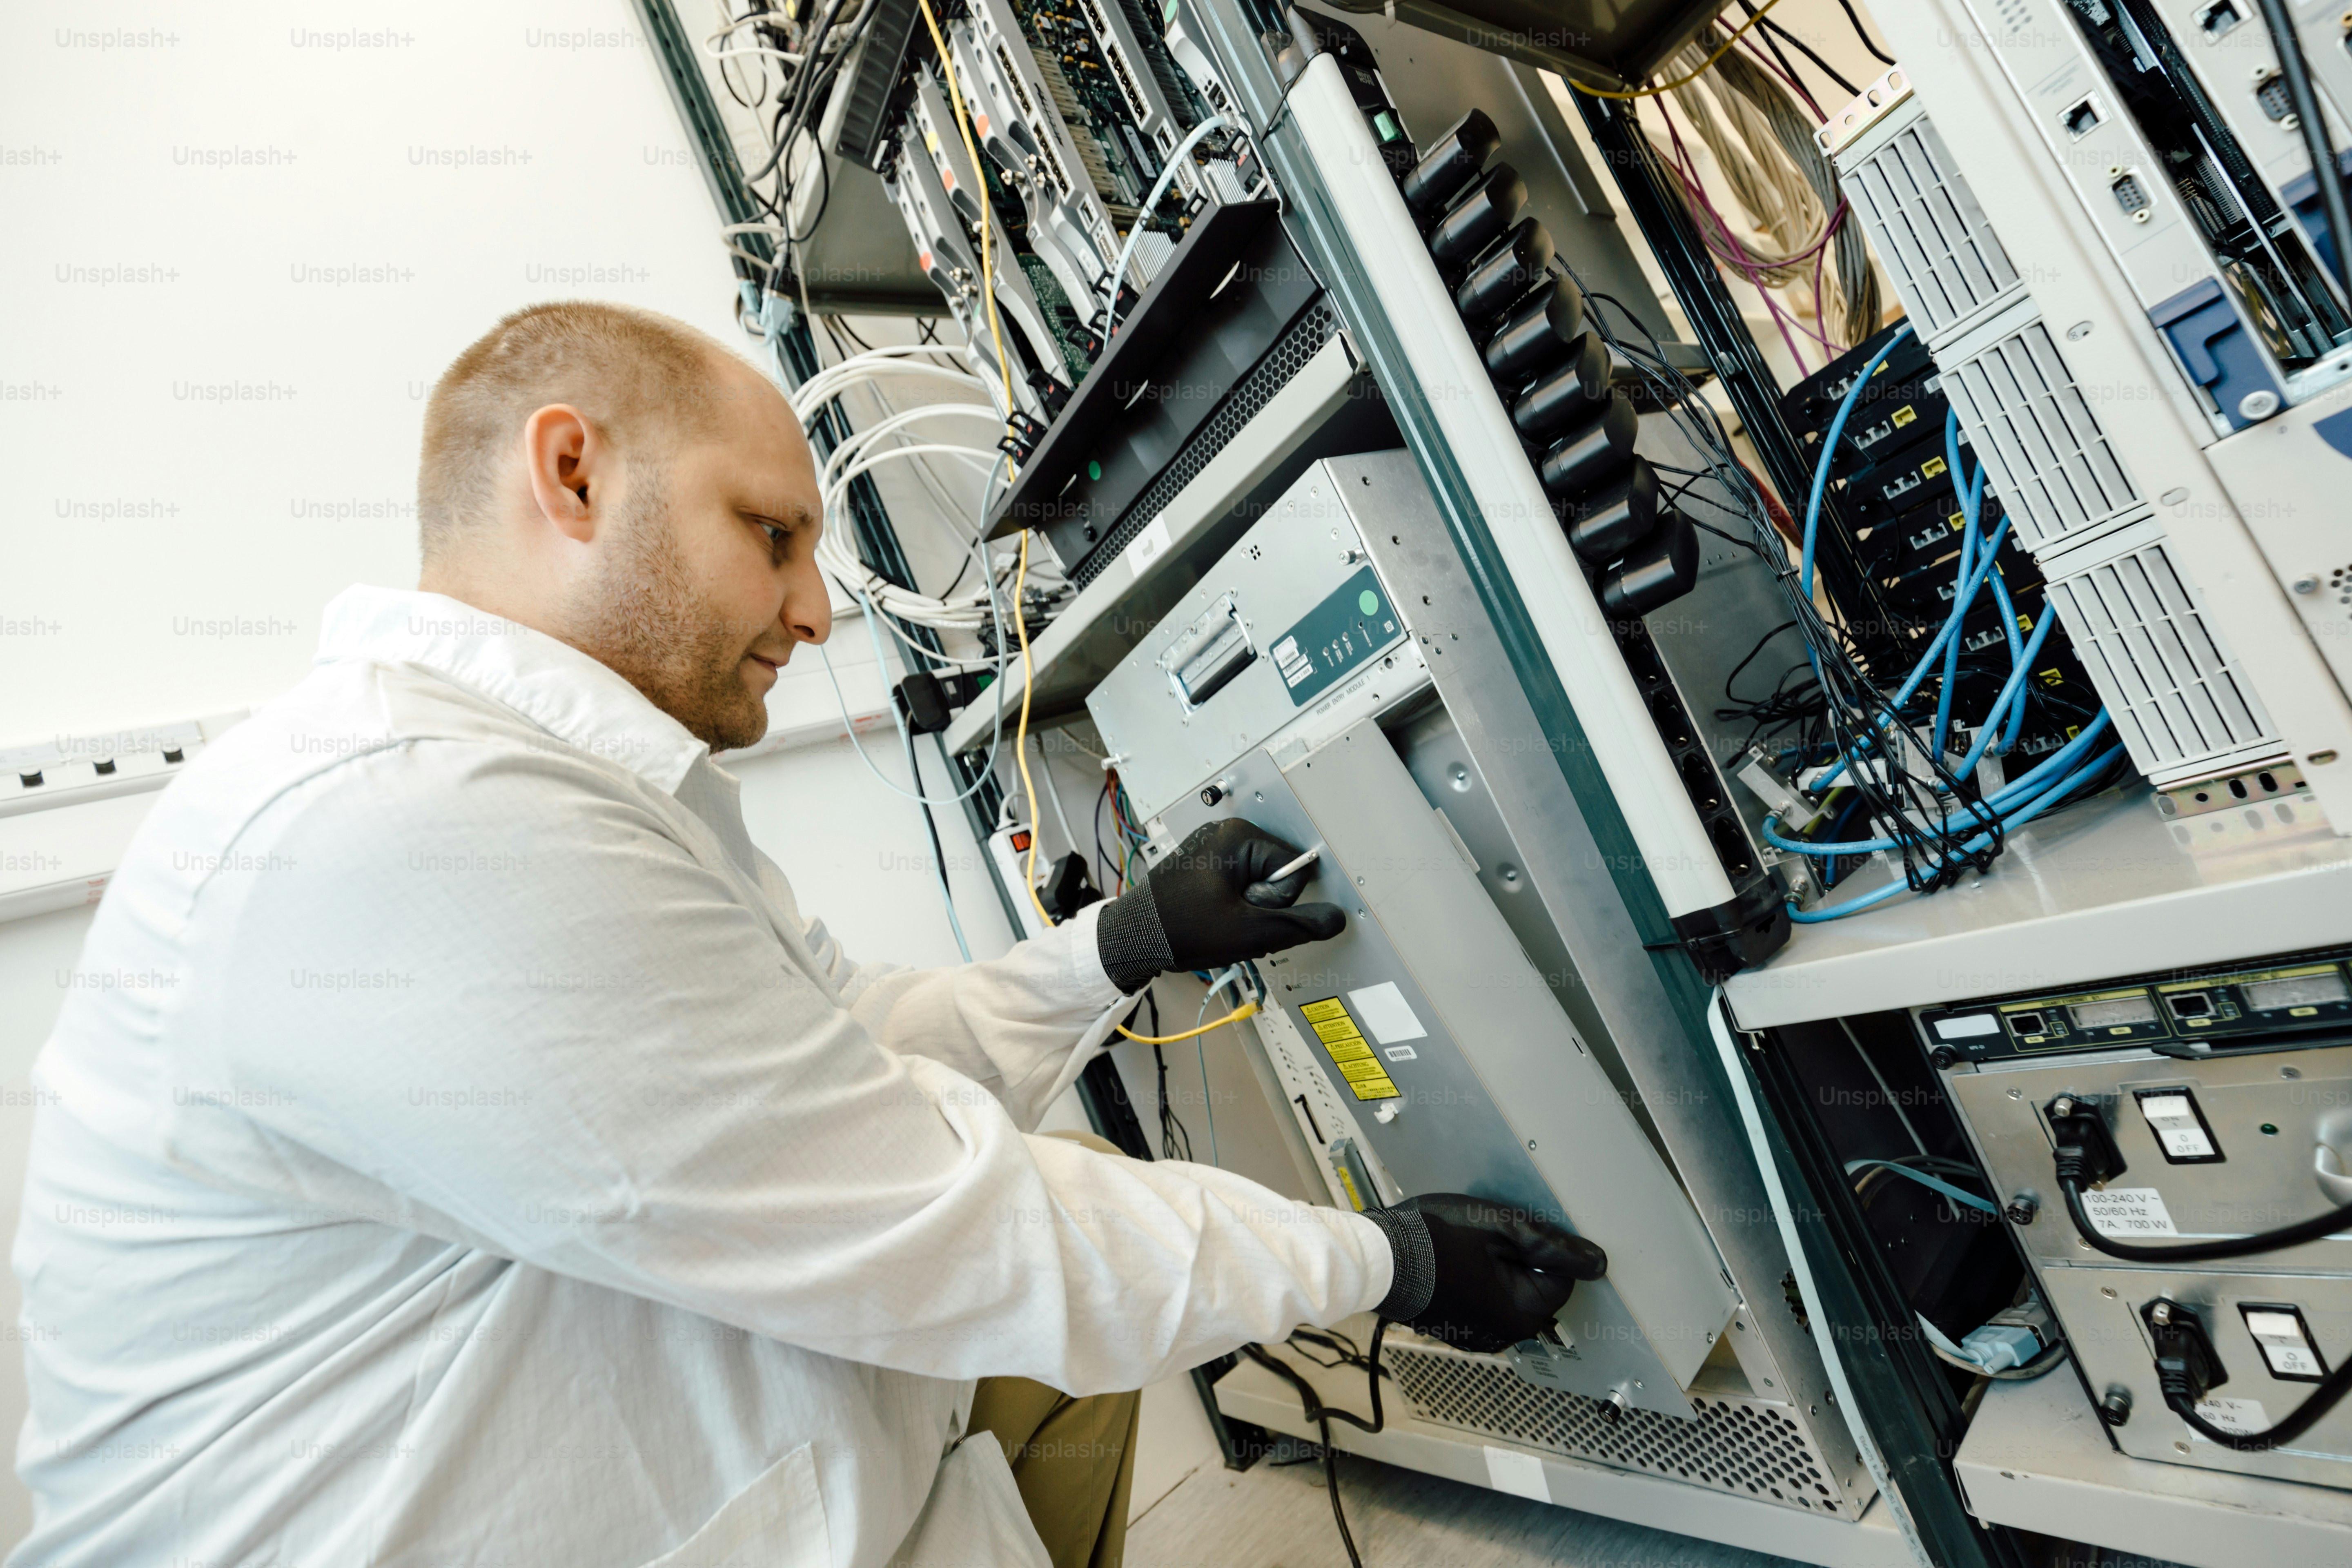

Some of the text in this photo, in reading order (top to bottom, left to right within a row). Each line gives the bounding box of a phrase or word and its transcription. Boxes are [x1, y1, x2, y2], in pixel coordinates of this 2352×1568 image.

[1316, 702, 1331, 716] POWER
[1332, 692, 1345, 705] ENTRY
[1346, 678, 1365, 695] MODULE
[1311, 1004, 1330, 1012] CAUTION
[1323, 1021, 1346, 1029] ATTENTION
[1335, 1040, 1362, 1049] PRECAUCIÓN
[2176, 1145, 2200, 1153] OFF
[2085, 1194, 2134, 1203] 100-240
[2135, 1194, 2146, 1203] V
[2093, 1207, 2149, 1216] 50/60 Hz
[2125, 1220, 2150, 1229] 700
[2151, 1220, 2167, 1229] W
[2282, 1361, 2307, 1370] OFF
